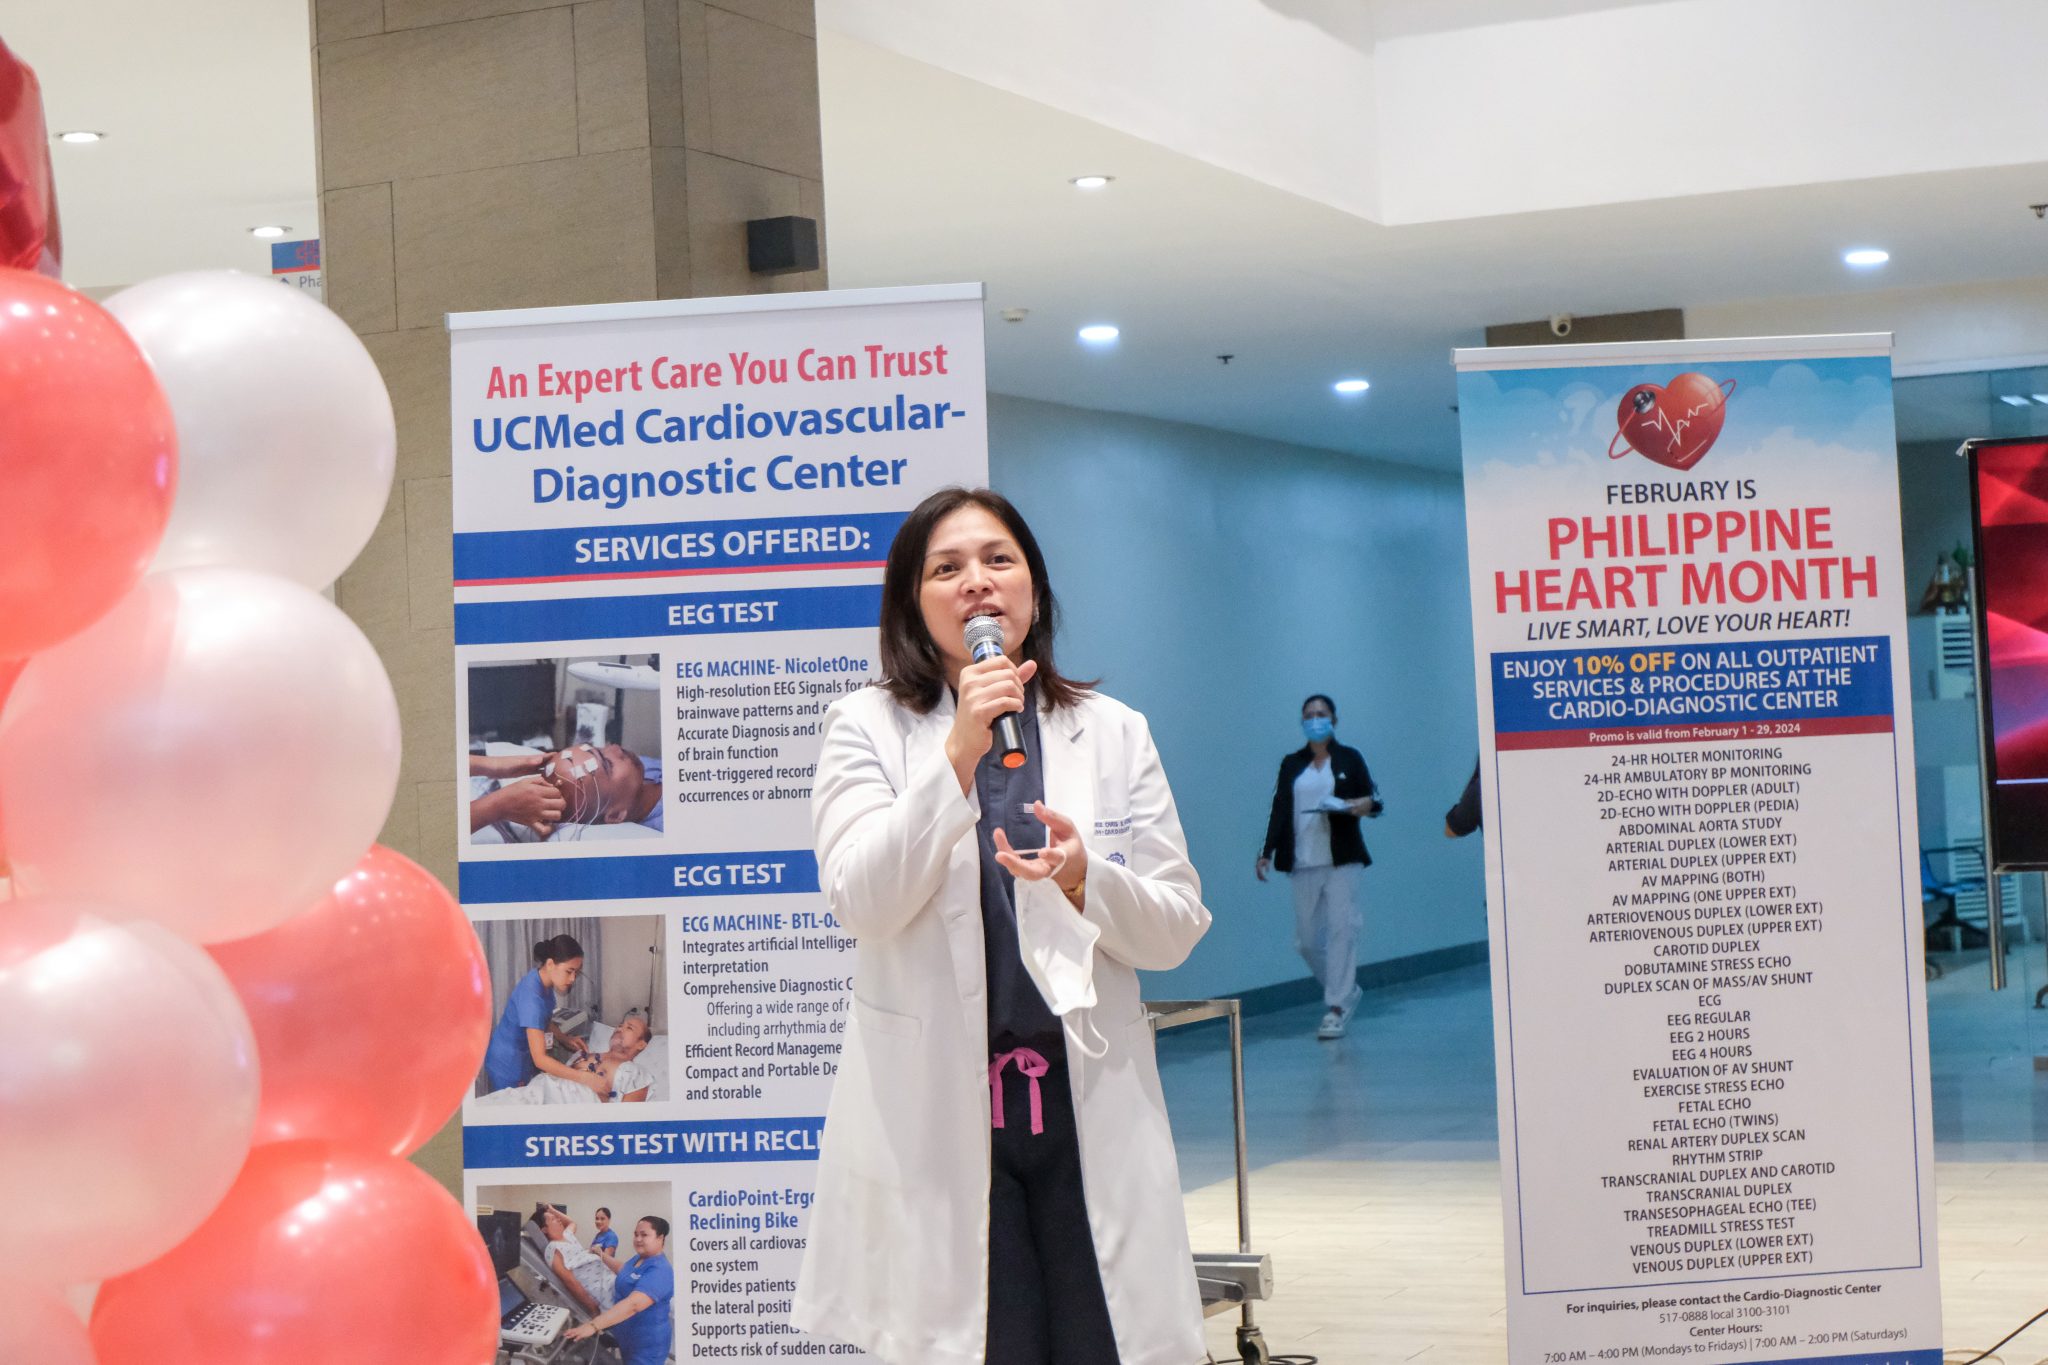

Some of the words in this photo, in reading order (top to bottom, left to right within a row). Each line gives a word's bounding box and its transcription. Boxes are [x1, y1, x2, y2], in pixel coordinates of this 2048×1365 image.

[486, 366, 528, 399] An
[538, 361, 642, 404] Expert
[651, 356, 722, 390] Care
[728, 352, 788, 386] You
[797, 349, 856, 382] Can
[864, 344, 948, 378] Trust
[473, 409, 624, 453] UCMed
[635, 394, 965, 444] Cardiovascular-
[533, 461, 756, 509] Diagnostic
[766, 454, 907, 491] Center
[1606, 480, 1729, 505] FEBRUARY
[1736, 479, 1756, 499] IS
[1548, 507, 1833, 560] PHILIPPINE
[575, 532, 715, 563] SERVICES
[722, 526, 870, 556] OFFERED:
[1494, 564, 1667, 614] HEART
[1682, 555, 1878, 606] MONTH
[668, 603, 714, 626] EEG
[718, 601, 778, 623] TEST
[1527, 621, 1571, 641] LIVE
[1576, 617, 1650, 639] SMART,
[1656, 615, 1709, 635] LOVE
[1714, 612, 1772, 632] YOUR
[1777, 609, 1850, 630] HEART!
[676, 661, 703, 679] EEG
[707, 659, 781, 677] MACHINE-
[785, 655, 868, 674] NicoletOne
[1503, 658, 1567, 679] ENJOY
[1573, 654, 1625, 675] 10%
[1629, 652, 1675, 673] OFF
[1680, 652, 1710, 670] ON
[1716, 650, 1753, 669] ALL
[1756, 644, 1878, 667] OUTPATIENT
[676, 683, 771, 702] High-resolution
[774, 680, 796, 695] EEG
[798, 679, 842, 698] Signals
[844, 678, 863, 693] for
[1532, 677, 1625, 699] SERVICES
[1629, 676, 1644, 695] &
[1649, 670, 1781, 694] PROCEDURES
[1785, 669, 1810, 687] AT
[1812, 667, 1851, 686] THE
[677, 706, 740, 720] brainwave
[742, 704, 793, 721] patterns
[796, 700, 819, 715] and
[1548, 692, 1758, 720] CARDIO-DIAGNOSTIC
[1762, 689, 1838, 710] CENTER
[677, 727, 729, 741] Accurate
[732, 724, 790, 742] Diagnosis
[792, 721, 815, 736] and
[1589, 731, 1624, 742] Promo
[1626, 730, 1635, 741] is
[1636, 728, 1663, 740] valid
[1664, 728, 1691, 739] from
[1692, 726, 1739, 738] February
[1742, 725, 1747, 735] 1
[1756, 724, 1773, 735] 29,
[1775, 723, 1801, 734] 2024
[1611, 753, 1648, 767] 24-HR
[1651, 751, 1699, 764] HOLTER
[1701, 747, 1782, 762] MONITORING
[678, 765, 773, 784] Event-triggered
[678, 790, 749, 803] occurrences
[752, 789, 765, 800] or
[1600, 805, 1655, 820] 2D-ECHO
[1657, 804, 1691, 816] WITH
[1694, 801, 1751, 815] DOPPLER
[1753, 798, 1799, 813] (PEDIA)
[1618, 821, 1695, 836] ABDOMINAL
[1698, 819, 1739, 832] AORTA
[1742, 817, 1782, 830] STUDY
[1608, 857, 1667, 872] ARTERIAL
[1670, 854, 1718, 869] DUPLEX
[1721, 852, 1766, 867] (UPPER
[1769, 851, 1796, 864] EXT)
[674, 865, 721, 887] ECG
[725, 863, 786, 885] TEST
[1612, 894, 1628, 906] AV
[1631, 891, 1690, 905] MAPPING
[1693, 889, 1722, 904] (ONE
[1725, 887, 1766, 901] UPPER
[1769, 885, 1796, 898] EXT)
[682, 915, 709, 933] ECG
[713, 913, 788, 932] MACHINE-
[1589, 926, 1694, 943] ARTERIOVENOUS
[1696, 923, 1744, 937] DUPLEX
[1747, 920, 1792, 936] (UPPER
[1795, 919, 1822, 932] EXT)
[682, 939, 745, 956] Integrates
[747, 936, 798, 952] artificial
[1653, 942, 1709, 957] CAROTID
[1711, 940, 1760, 954] DUPLEX
[683, 960, 768, 977] interpretation
[1624, 960, 1708, 976] DOBUTAMINE
[1710, 957, 1754, 971] STRESS
[1757, 955, 1791, 969] ECHO
[683, 979, 776, 998] Comprehensive
[779, 977, 843, 996] Diagnostic
[1698, 994, 1721, 1007] ECG
[1667, 1013, 1691, 1026] EEG
[1694, 1010, 1751, 1025] REGULAR
[685, 1043, 733, 1058] Efficient
[735, 1041, 774, 1057] Record
[1672, 1048, 1696, 1061] EEG
[1699, 1048, 1707, 1059] 4
[1710, 1044, 1752, 1059] HOURS
[685, 1065, 738, 1082] Compact
[741, 1063, 764, 1078] and
[767, 1061, 820, 1077] Portable
[1633, 1065, 1710, 1081] EVALUATION
[1712, 1063, 1728, 1076] OF
[1731, 1062, 1748, 1075] AV
[1751, 1060, 1793, 1074] SHUNT
[1678, 1100, 1715, 1113] FETAL
[1718, 1097, 1751, 1111] ECHO
[525, 1134, 614, 1157] STRESS
[618, 1133, 678, 1154] TEST
[681, 1131, 748, 1153] WITH
[1645, 1185, 1741, 1203] TRANSCRANIAL
[1743, 1182, 1792, 1197] DUPLEX
[1623, 1202, 1746, 1222] TRANSESOPHAGEAL
[1748, 1200, 1783, 1214] ECHO
[1786, 1198, 1816, 1212] (TEE)
[689, 1213, 760, 1233] Reclining
[765, 1211, 798, 1228] Bike
[1632, 1258, 1683, 1274] VENOUS
[1686, 1255, 1735, 1271] DUPLEX
[1738, 1252, 1783, 1268] (UPPER
[1785, 1250, 1813, 1264] EXT)
[691, 1278, 742, 1294] Provides
[745, 1279, 796, 1296] patients
[690, 1300, 712, 1315] the
[714, 1299, 754, 1314] lateral
[757, 1300, 791, 1317] positi
[1566, 1303, 1585, 1314] For
[1587, 1300, 1639, 1314] inquiries,
[1641, 1297, 1677, 1311] please
[1679, 1294, 1721, 1306] contact
[1722, 1292, 1741, 1303] the
[1743, 1285, 1843, 1302] Cardio-Diagnostic
[1844, 1284, 1881, 1294] Center
[1659, 1310, 1708, 1324] 517-0888
[1710, 1308, 1734, 1320] local
[1736, 1304, 1789, 1318] 3100-3101
[1689, 1326, 1725, 1337] Center
[1727, 1324, 1762, 1334] Hours:
[692, 1343, 738, 1357] Detects
[741, 1341, 763, 1356] risk
[765, 1341, 779, 1356] of
[780, 1340, 826, 1356] sudden
